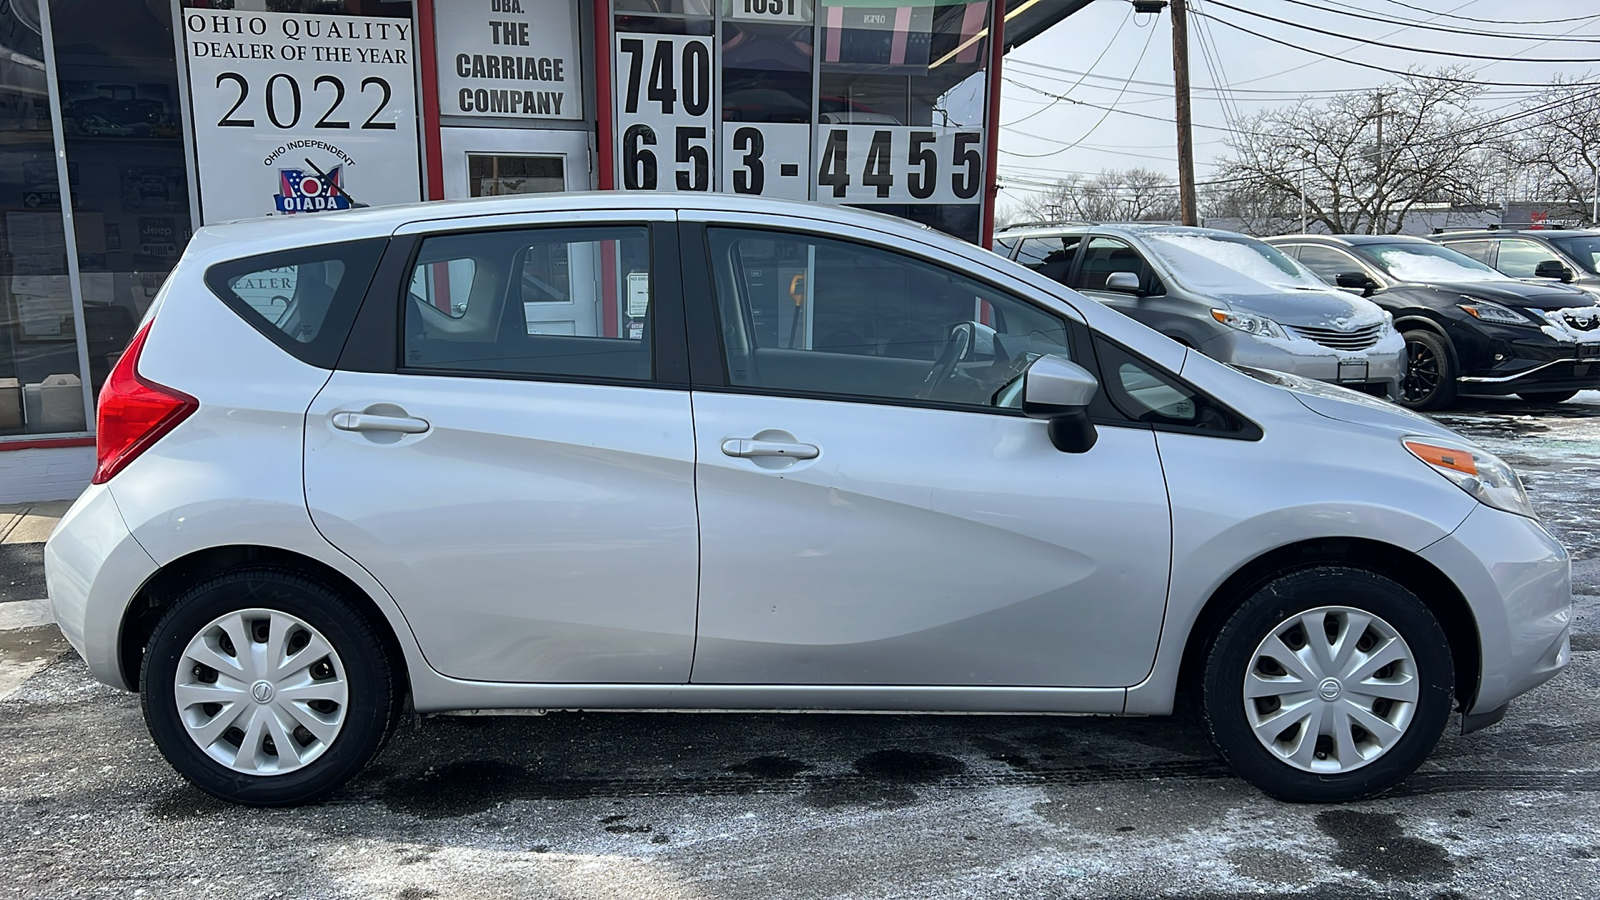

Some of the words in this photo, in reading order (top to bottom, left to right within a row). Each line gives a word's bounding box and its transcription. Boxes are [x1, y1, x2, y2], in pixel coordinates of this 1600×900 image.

[187, 14, 267, 36] OHIO
[282, 20, 410, 42] QUALITY
[488, 20, 530, 47] THE
[193, 41, 276, 60] DEALER
[280, 44, 307, 62] OF
[311, 46, 352, 63] THE
[356, 47, 408, 65] YEAR
[456, 52, 564, 82] CARRIAGE
[620, 38, 710, 117] 740
[215, 72, 397, 130] 2022
[459, 88, 564, 116] COMPANY
[263, 146, 286, 167] OHIO
[286, 139, 356, 167] INDEPENDENT
[283, 197, 338, 211] OIADA
[143, 225, 172, 236] Jeep
[233, 277, 292, 290] EALER
